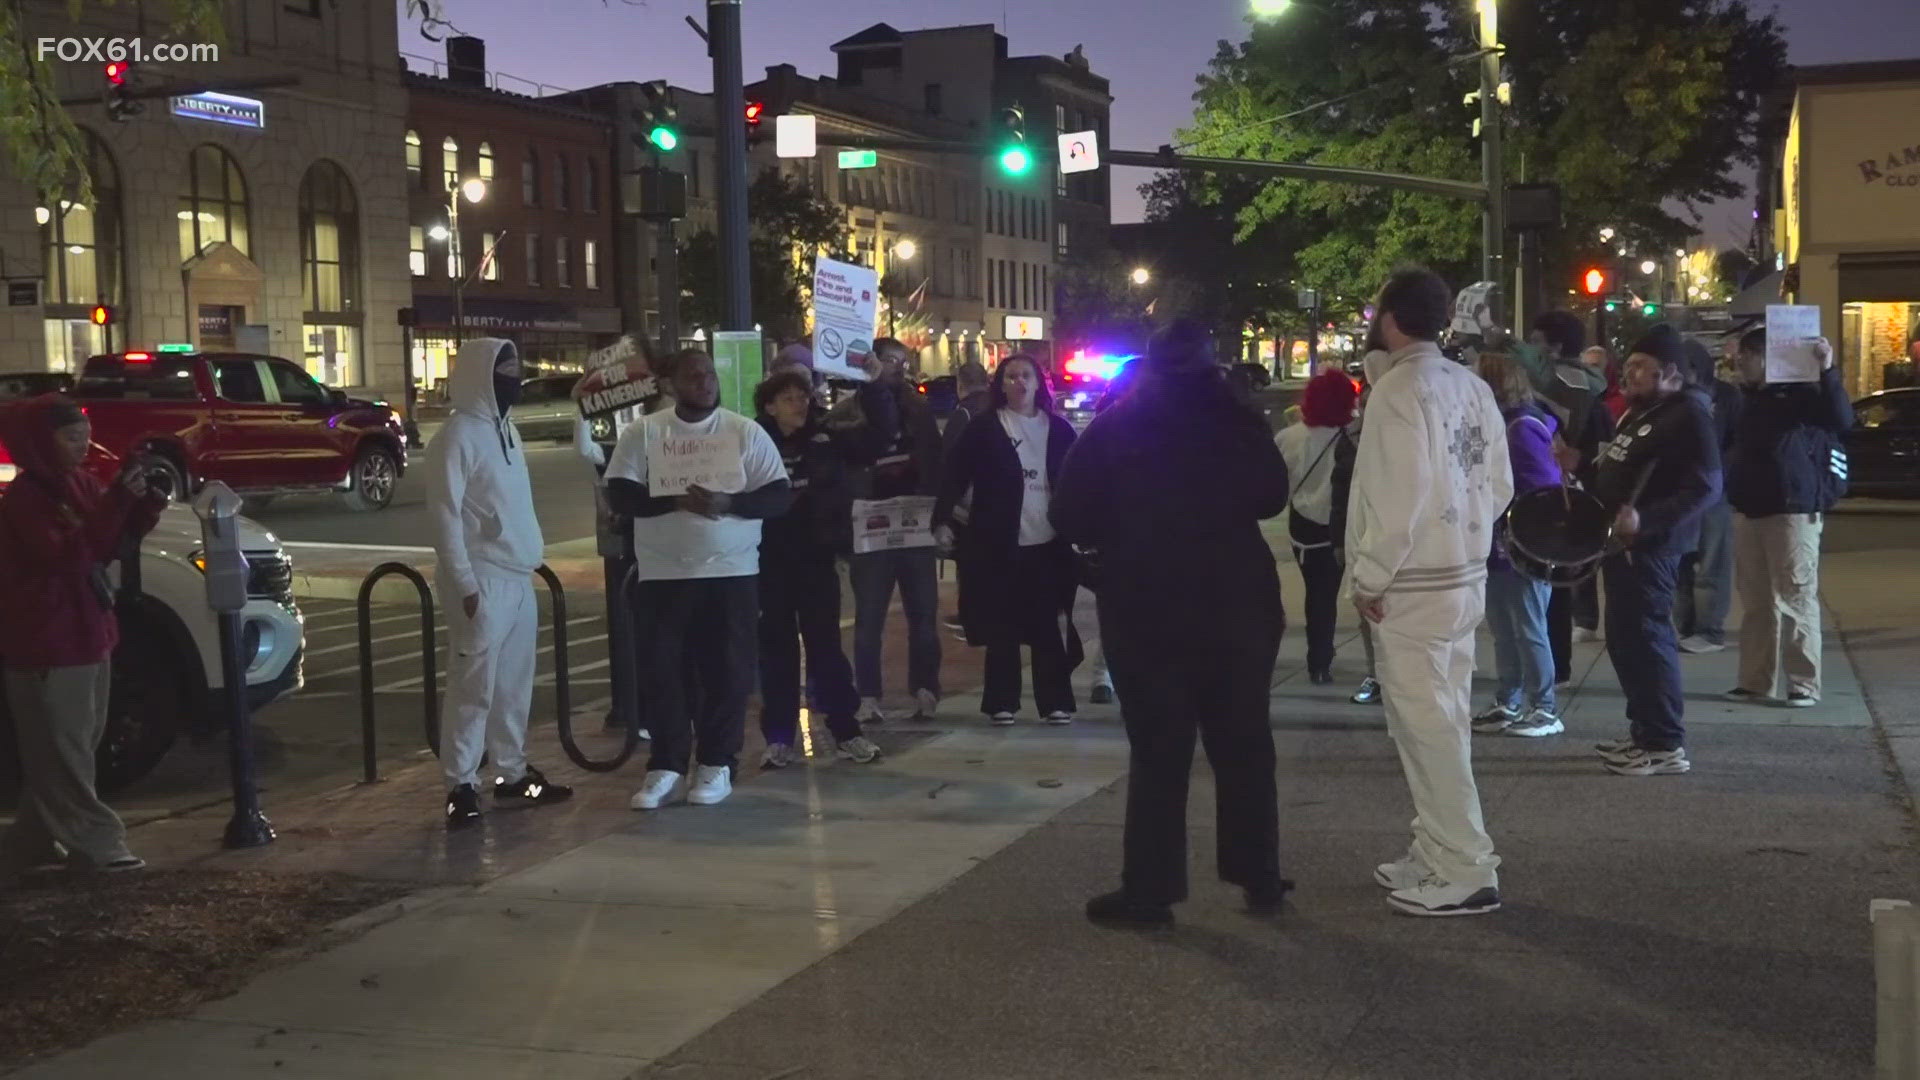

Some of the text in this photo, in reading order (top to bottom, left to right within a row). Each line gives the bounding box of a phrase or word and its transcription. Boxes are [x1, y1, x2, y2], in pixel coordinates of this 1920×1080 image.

[177, 97, 230, 115] LIBERTY
[1886, 175, 1920, 186] CLO
[601, 363, 629, 388] FOR
[582, 376, 658, 414] KATHERINE
